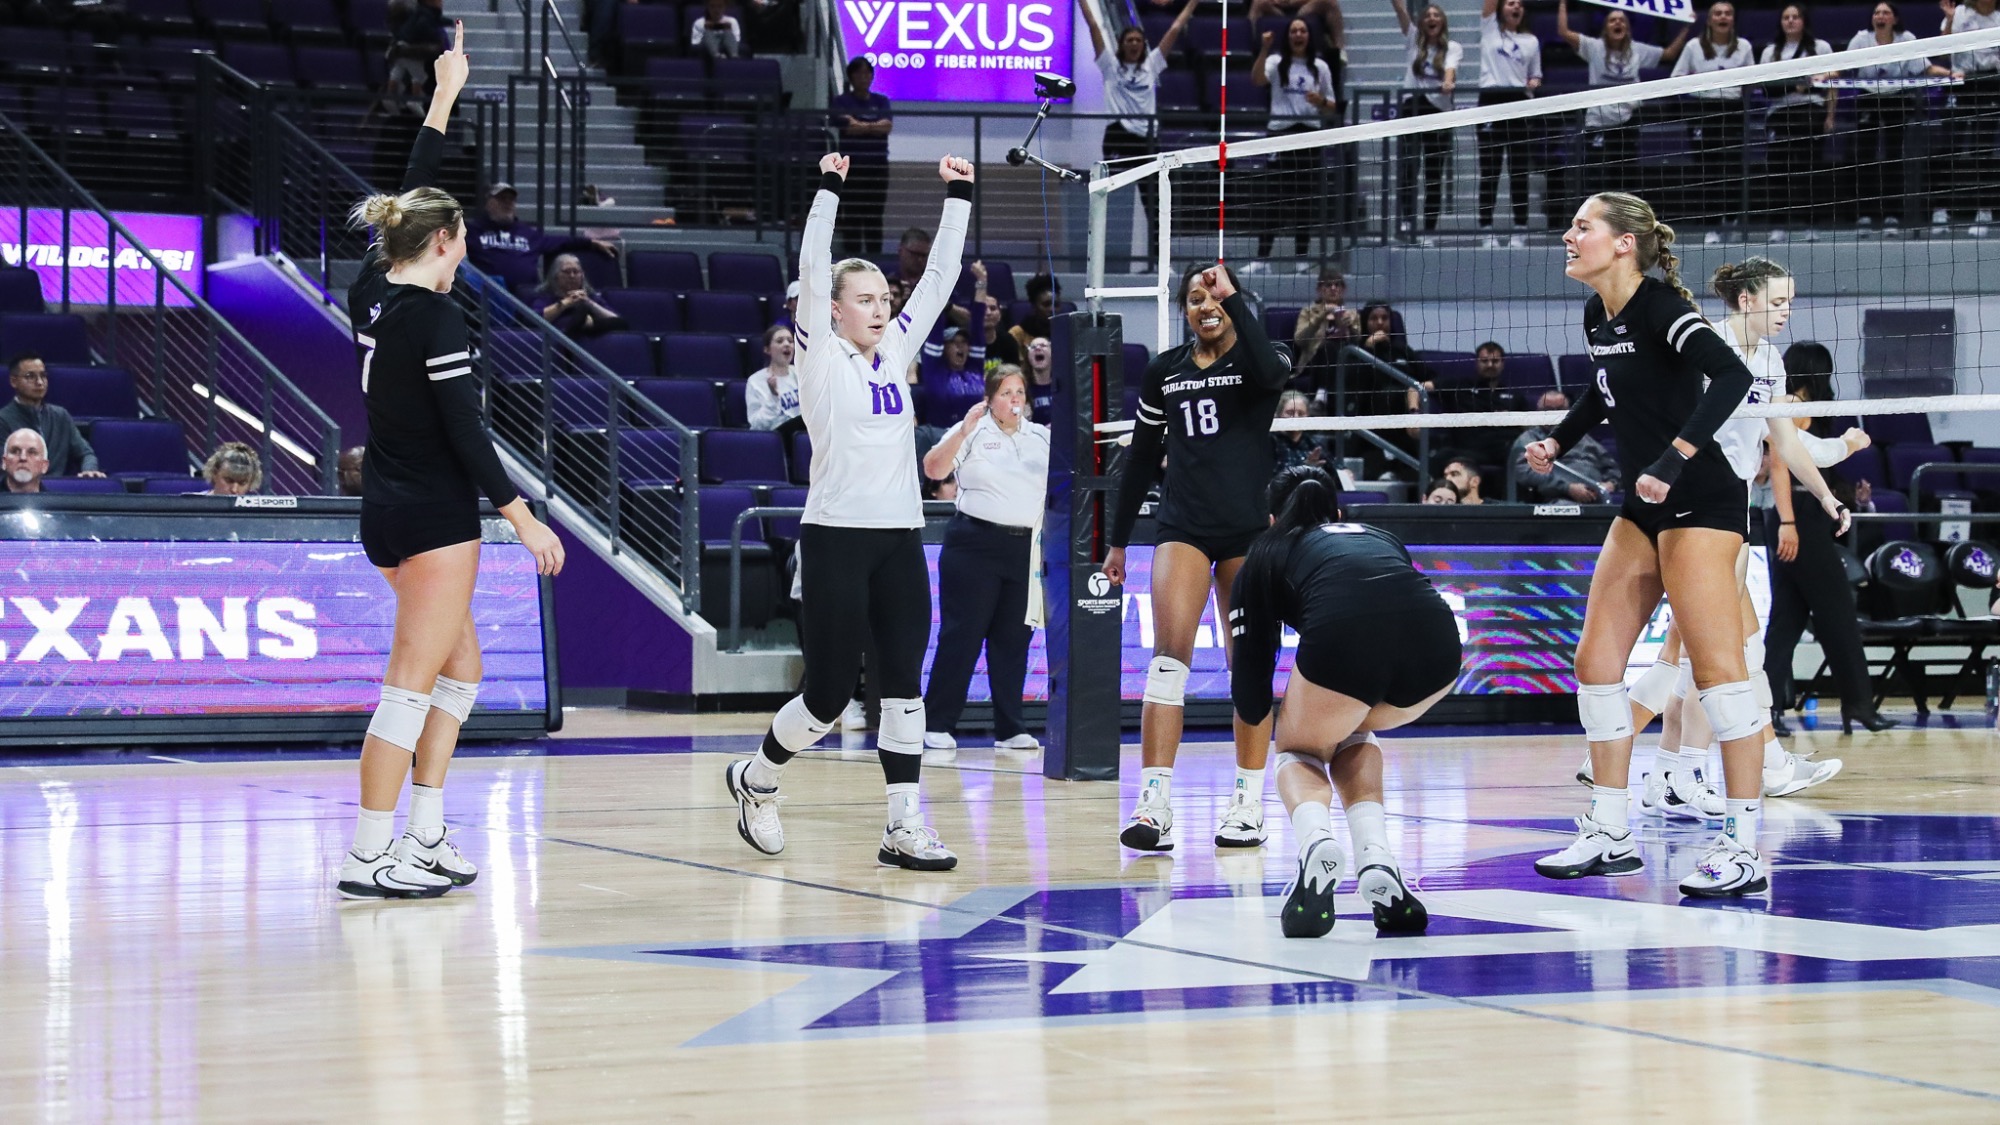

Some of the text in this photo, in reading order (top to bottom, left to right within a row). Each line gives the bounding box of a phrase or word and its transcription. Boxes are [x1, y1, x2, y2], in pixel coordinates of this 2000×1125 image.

[1600, 0, 1685, 15] MP
[844, 1, 1054, 50] VEXUS
[935, 54, 1053, 70] FIBER INTERNET
[0, 243, 195, 271] WILDCATS!
[357, 332, 376, 394] 7
[868, 380, 904, 415] 10
[1161, 375, 1243, 396] TARLETON STATE
[1596, 367, 1616, 408] 9
[1180, 398, 1219, 436] 18
[1891, 557, 1922, 577] ACU
[1964, 557, 1994, 577] ACU
[0, 596, 318, 662] XANS
